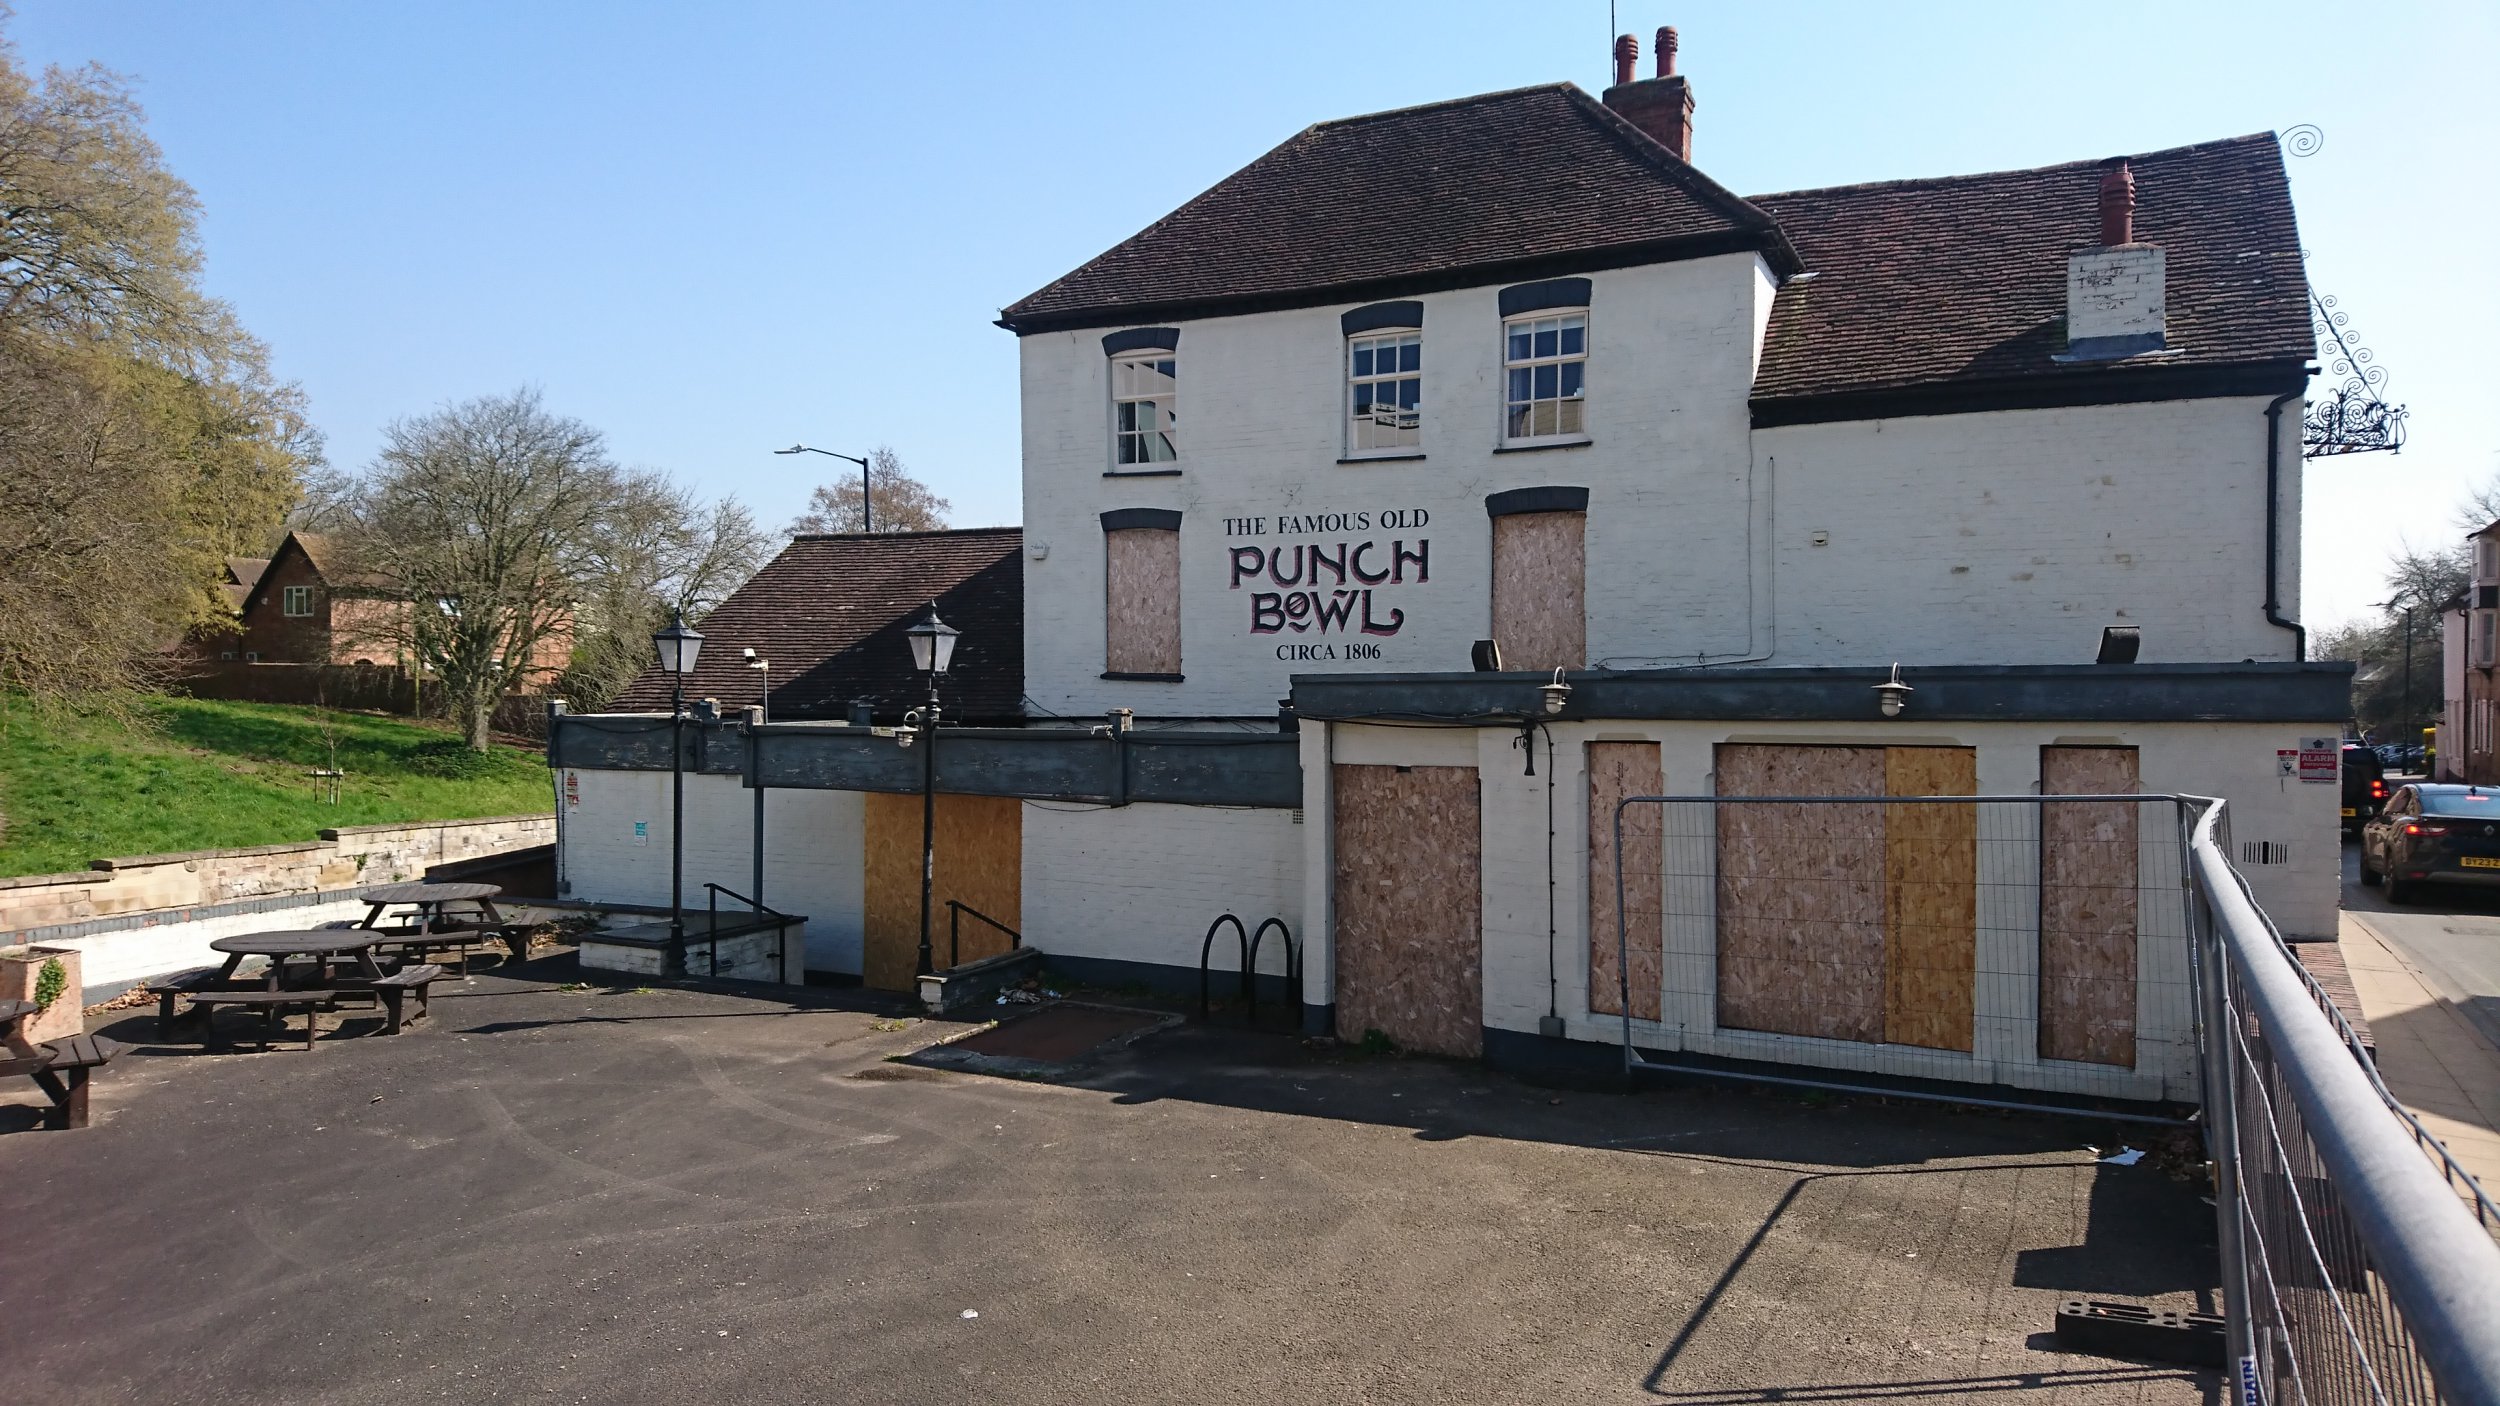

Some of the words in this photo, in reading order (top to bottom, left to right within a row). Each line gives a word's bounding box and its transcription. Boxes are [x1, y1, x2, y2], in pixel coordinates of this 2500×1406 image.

[1222, 517, 1267, 536] THE
[1278, 511, 1370, 534] FAMOUS
[1380, 508, 1430, 529] OLD
[1228, 539, 1430, 590] PUNCH
[1250, 589, 1405, 637] BOWL
[1276, 644, 1336, 661] CIRCA
[1344, 643, 1381, 660] 1806
[2241, 1360, 2257, 1406] RAIN
